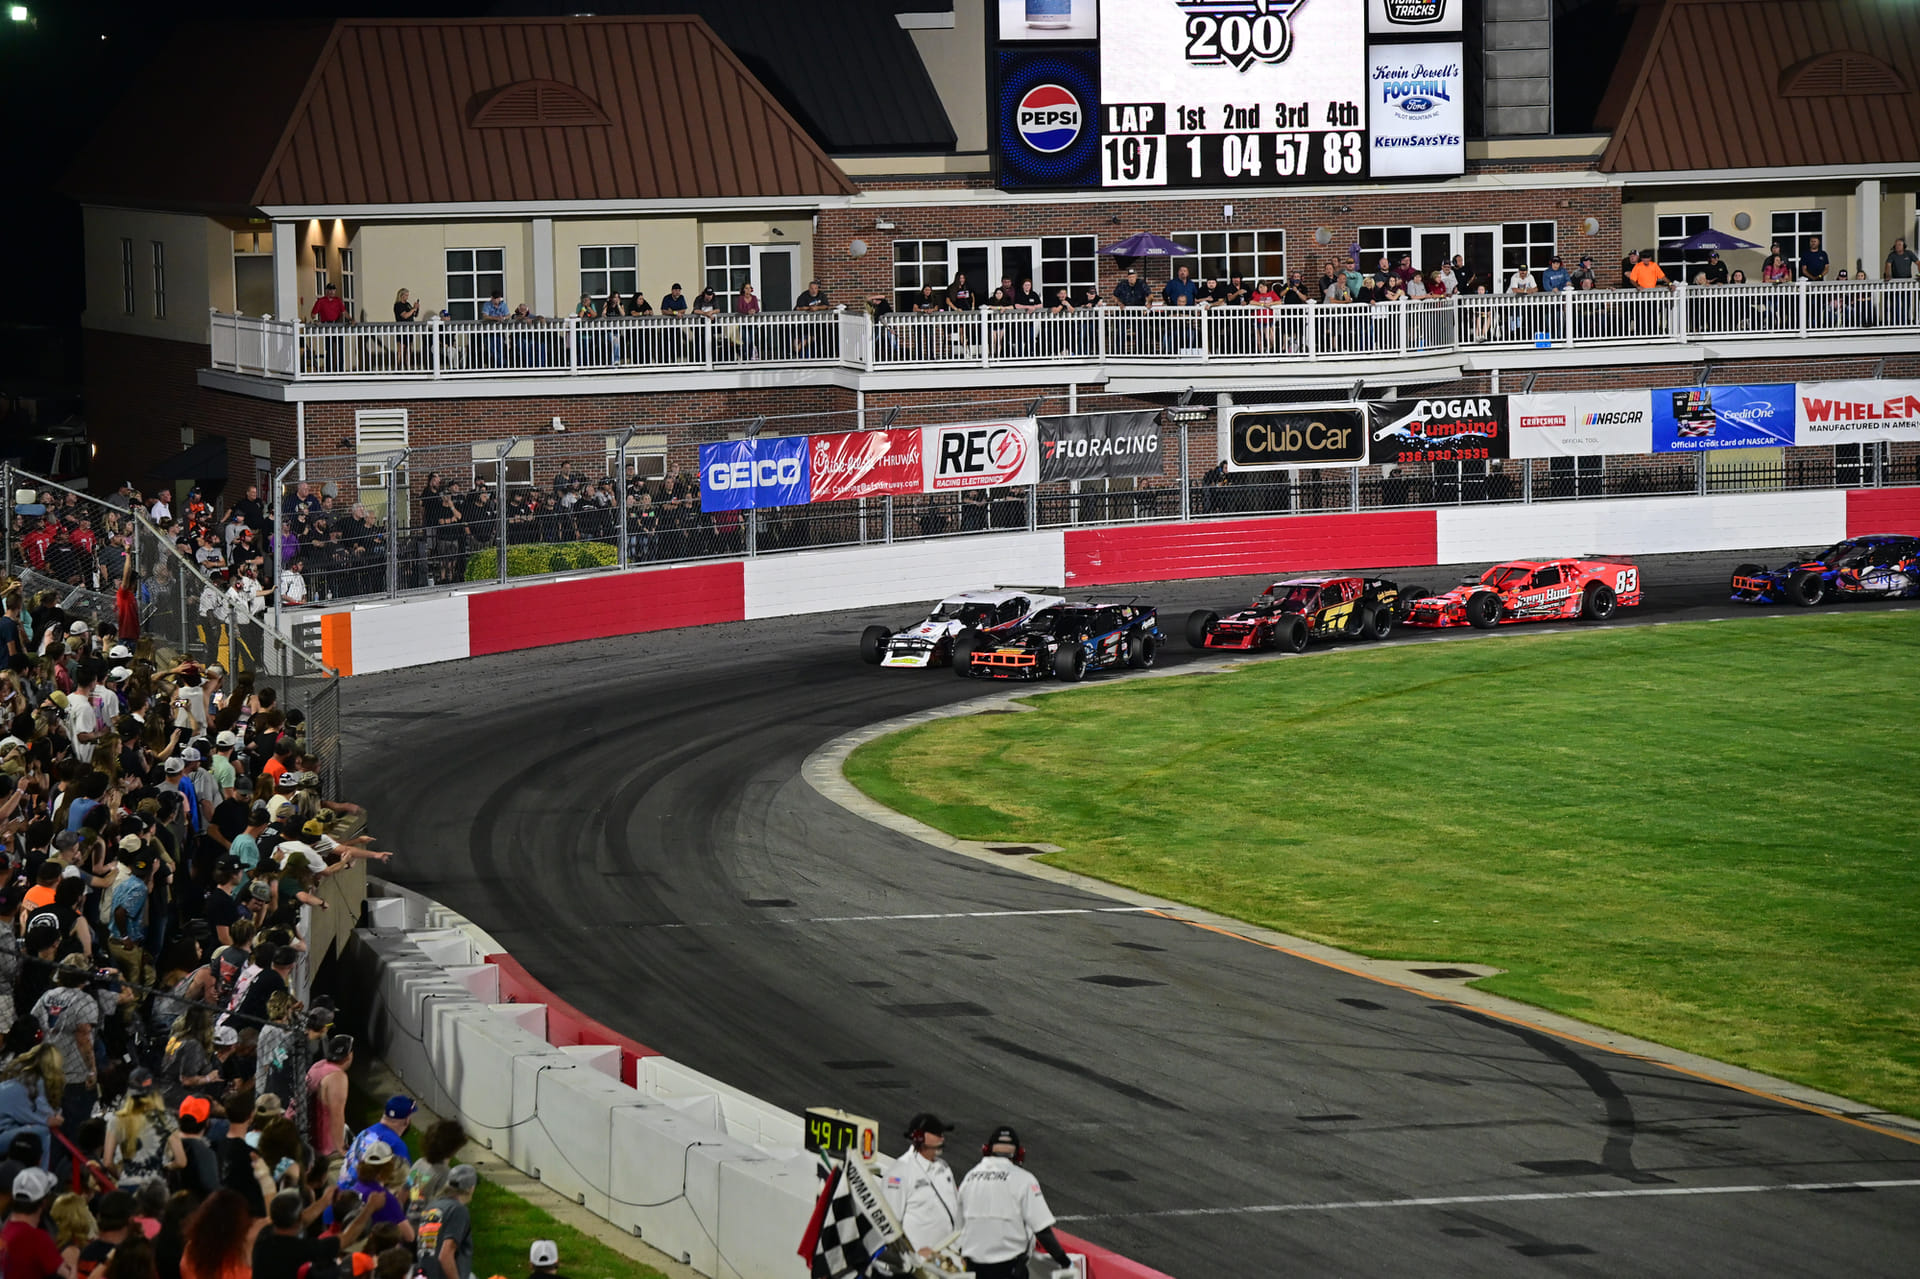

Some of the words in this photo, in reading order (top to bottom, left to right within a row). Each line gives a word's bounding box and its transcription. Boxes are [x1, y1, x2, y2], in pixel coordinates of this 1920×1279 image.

[1395, 4, 1436, 17] TRACKS
[1188, 15, 1285, 56] 200
[1373, 65, 1409, 80] Kevin
[1411, 63, 1459, 79] Powell's
[1383, 79, 1450, 104] FOOTHILL
[1406, 99, 1428, 110] Ford
[1021, 111, 1077, 125] PEPSI
[1108, 106, 1154, 133] LAP
[1176, 104, 1206, 130] 1st
[1223, 103, 1260, 130] 2nd
[1275, 102, 1309, 128] 3rd
[1326, 101, 1359, 126] 4th
[1105, 136, 1158, 180] 197
[1186, 136, 1202, 178] 1
[1222, 134, 1262, 177] 04
[1275, 133, 1310, 176] 57
[1323, 131, 1362, 175] 83
[1802, 395, 1920, 422] WHELEN
[1522, 415, 1564, 426] CRAFTSMAN
[1596, 411, 1643, 424] NASCAR
[1809, 422, 1880, 432] MANUFACTURED
[1882, 421, 1890, 429] IN
[1892, 420, 1920, 429] AMERI
[1245, 424, 1302, 452] Club
[1305, 421, 1351, 450] Car
[1671, 441, 1697, 449] Official
[1699, 440, 1719, 448] Credit
[1720, 438, 1737, 447] Card
[1737, 438, 1745, 446] of
[878, 451, 920, 467] THRUWAY
[708, 458, 800, 490] GEICO
[936, 478, 961, 487] RACING
[961, 475, 1004, 485] ELECTRONICS
[1615, 568, 1637, 594] 83
[1546, 585, 1571, 600] Hunt
[967, 1171, 1010, 1182] OFFICIAL
[871, 1208, 895, 1237] GRAY
